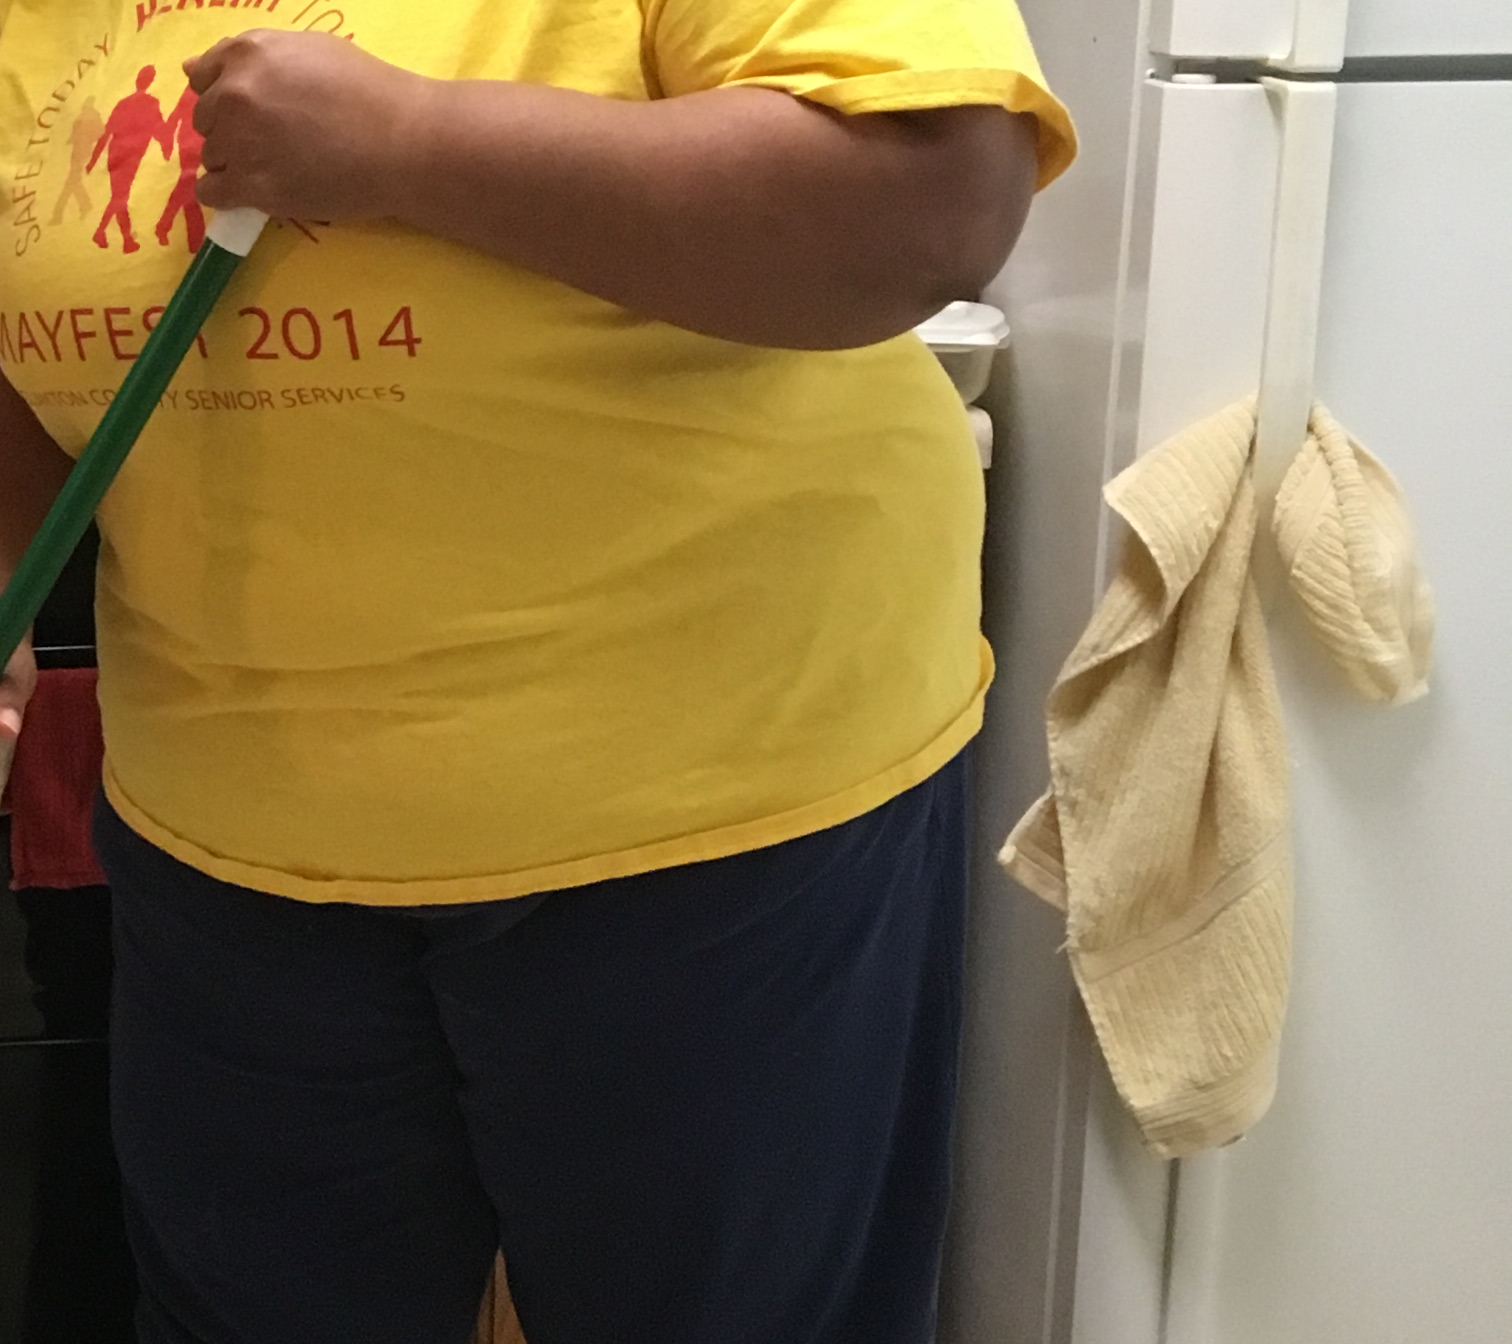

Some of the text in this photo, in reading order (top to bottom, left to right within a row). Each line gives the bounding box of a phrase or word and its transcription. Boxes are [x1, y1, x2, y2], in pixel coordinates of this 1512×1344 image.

[12, 159, 43, 257] SAFE
[238, 305, 423, 361] 2014
[185, 388, 276, 411] SENIOR
[280, 383, 406, 409] SERVICES
